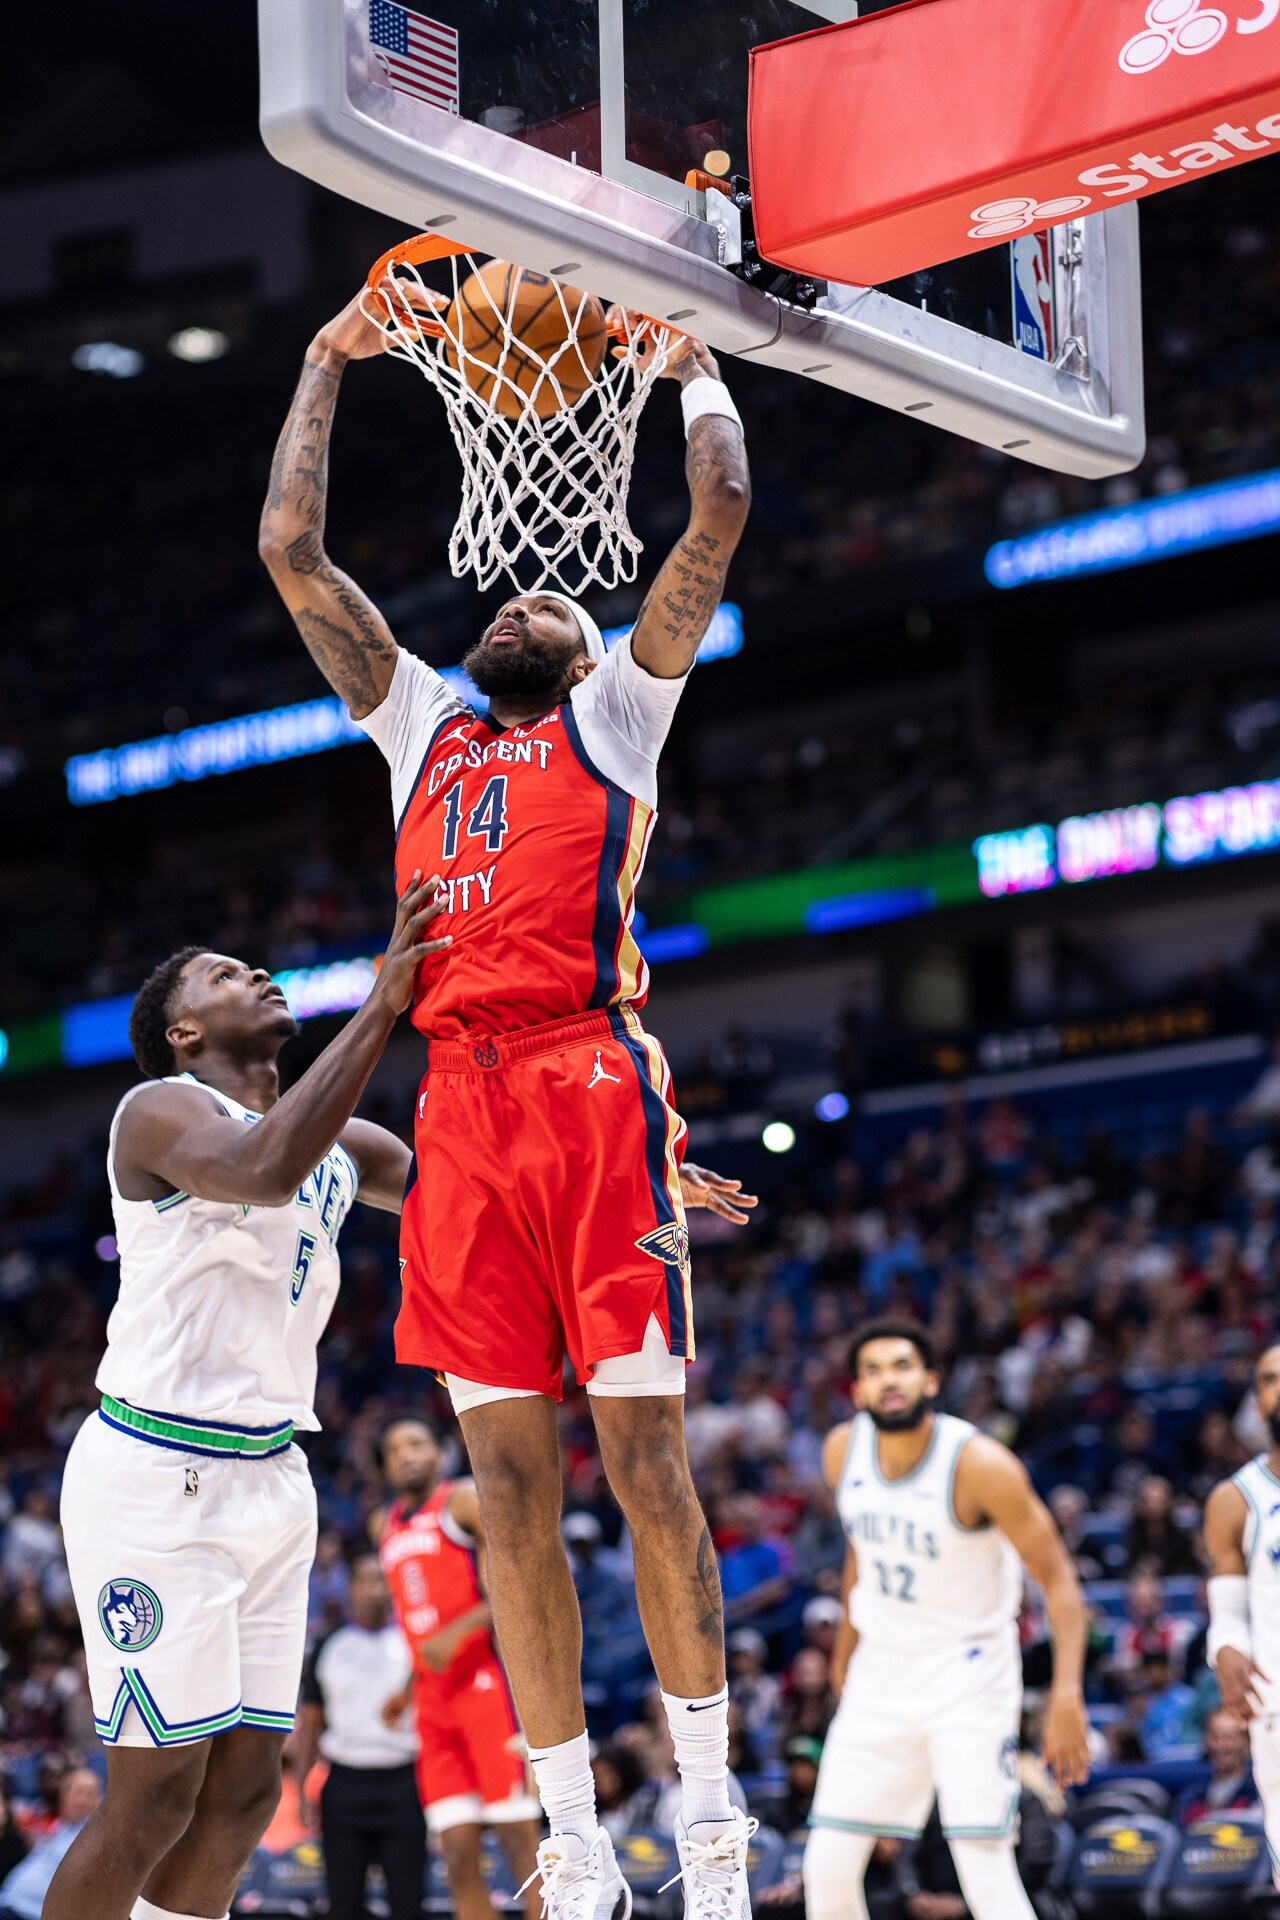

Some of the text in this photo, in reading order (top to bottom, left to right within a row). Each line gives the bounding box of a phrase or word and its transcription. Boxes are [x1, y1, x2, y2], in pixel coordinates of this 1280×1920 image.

[1019, 321, 1040, 352] NBA
[427, 739, 555, 797] CRSCENT
[441, 775, 509, 861] 14
[433, 864, 497, 915] CITY
[290, 1229, 318, 1307] 5
